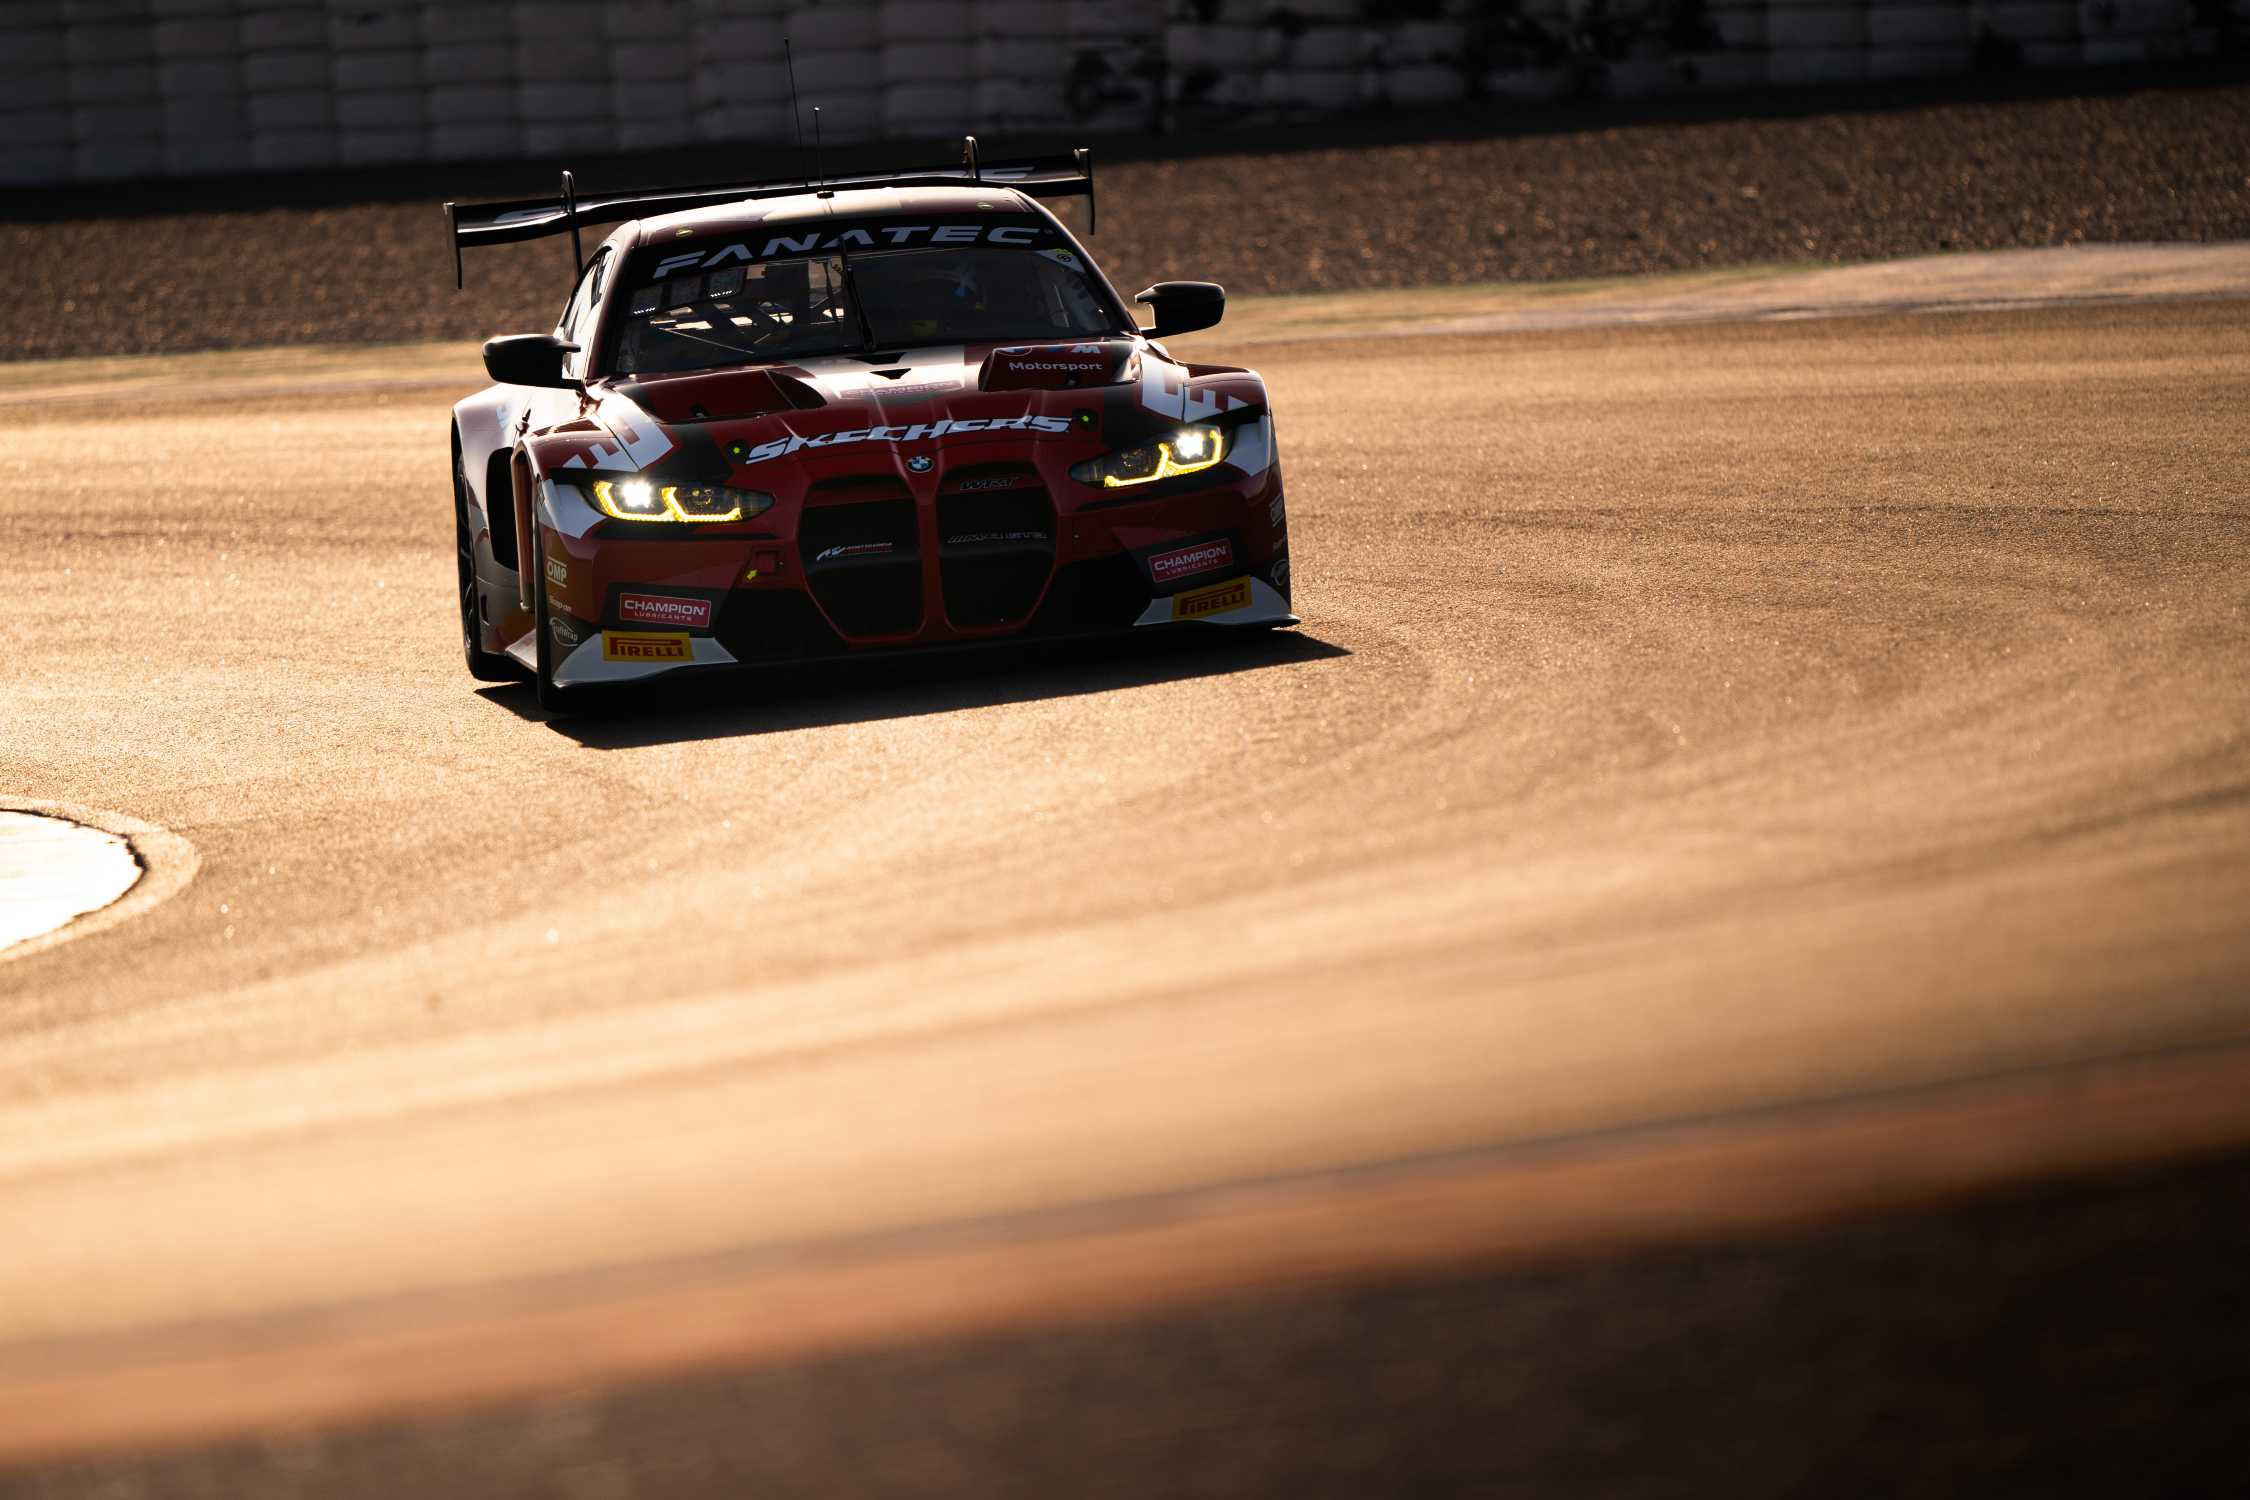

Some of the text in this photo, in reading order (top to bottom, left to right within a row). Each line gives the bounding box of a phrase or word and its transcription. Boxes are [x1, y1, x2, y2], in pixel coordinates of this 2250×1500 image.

[651, 225, 1041, 279] FANATEC
[1008, 361, 1103, 372] Motorsport
[745, 415, 1073, 464] SKECHERS
[1154, 546, 1226, 571] CHAMPION
[546, 560, 567, 583] OMP
[624, 599, 705, 616] CHAMPION
[1180, 583, 1245, 615] PIRELLI
[634, 611, 693, 622] LUBRICANTS
[609, 637, 684, 656] PIRELLI
